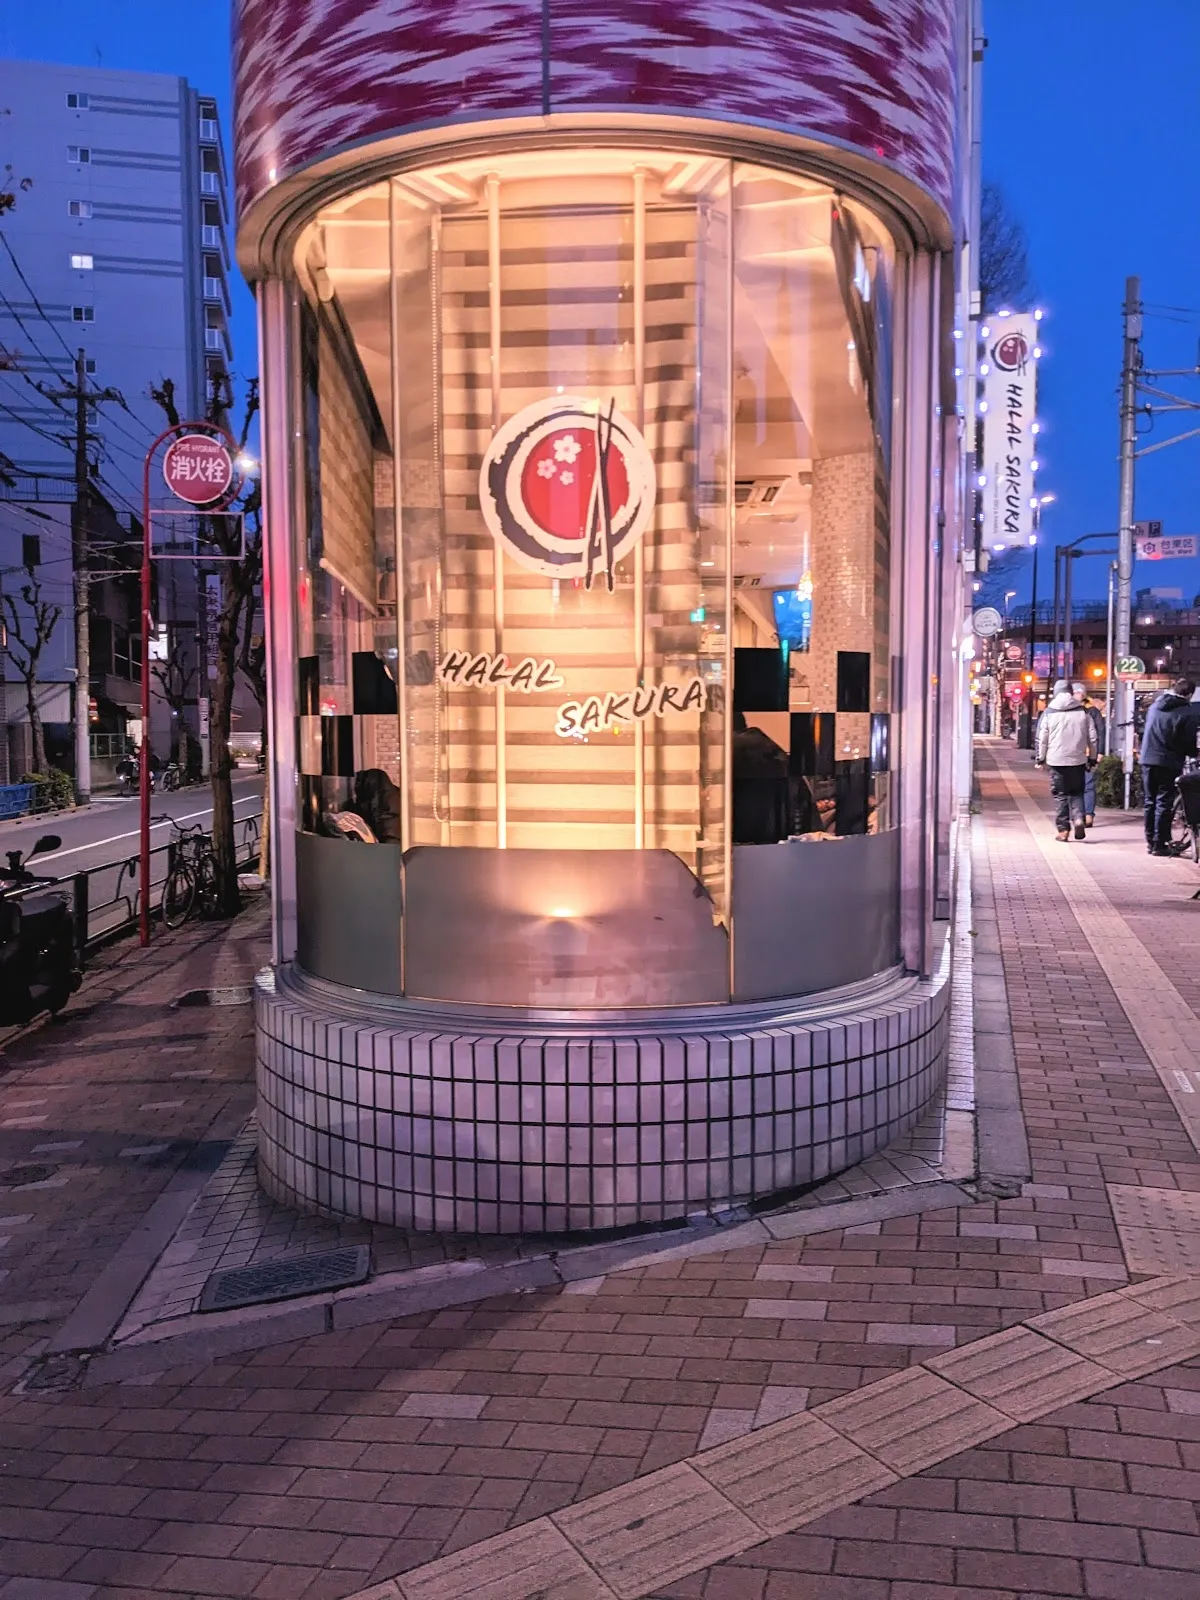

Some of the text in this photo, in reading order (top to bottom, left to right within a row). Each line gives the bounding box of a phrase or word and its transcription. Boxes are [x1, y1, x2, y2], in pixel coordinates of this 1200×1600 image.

[176, 443, 220, 453] FIRE HYDRANT
[1004, 383, 1023, 533] HALAL SAKURA
[171, 455, 226, 483] 消火栓
[1160, 538, 1193, 550] 台東区
[440, 652, 562, 690] HALAL
[1120, 657, 1138, 672] 22
[559, 680, 704, 733] SAKURA
